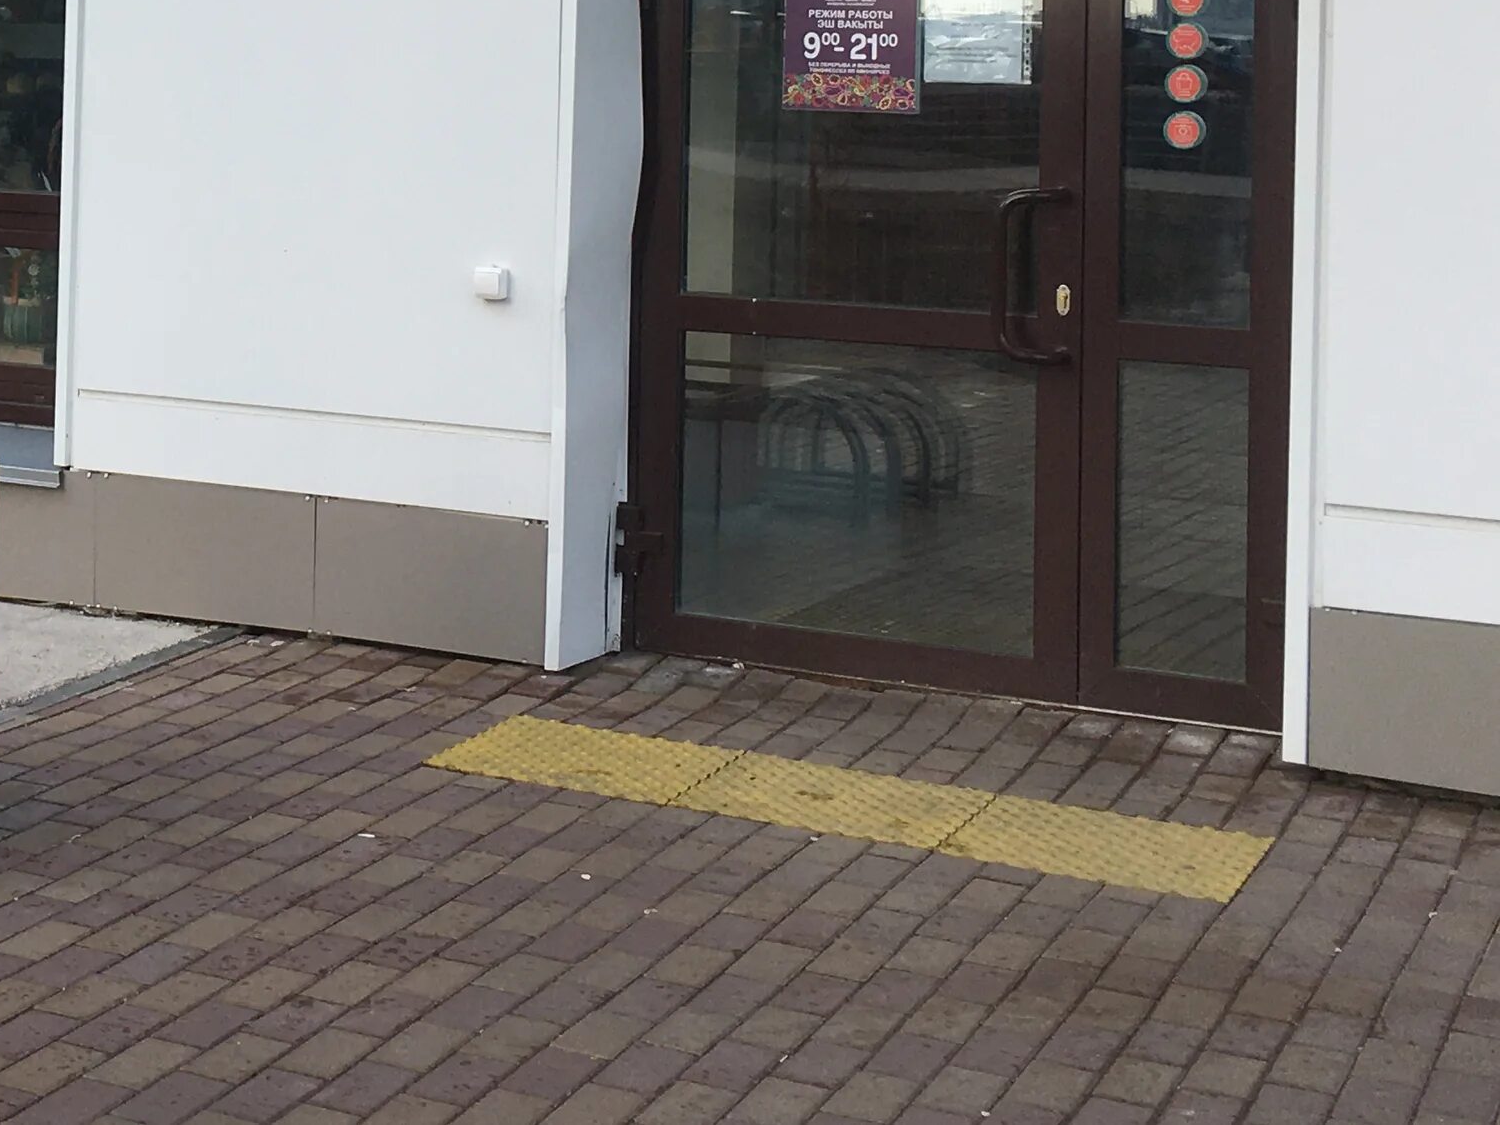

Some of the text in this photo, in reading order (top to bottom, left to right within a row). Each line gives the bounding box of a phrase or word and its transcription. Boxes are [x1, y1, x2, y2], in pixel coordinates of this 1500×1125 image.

[808, 9, 893, 20] РЕЖИМ РАБОТЫ
[817, 19, 884, 29] ЭШ ВАКЫТЫ
